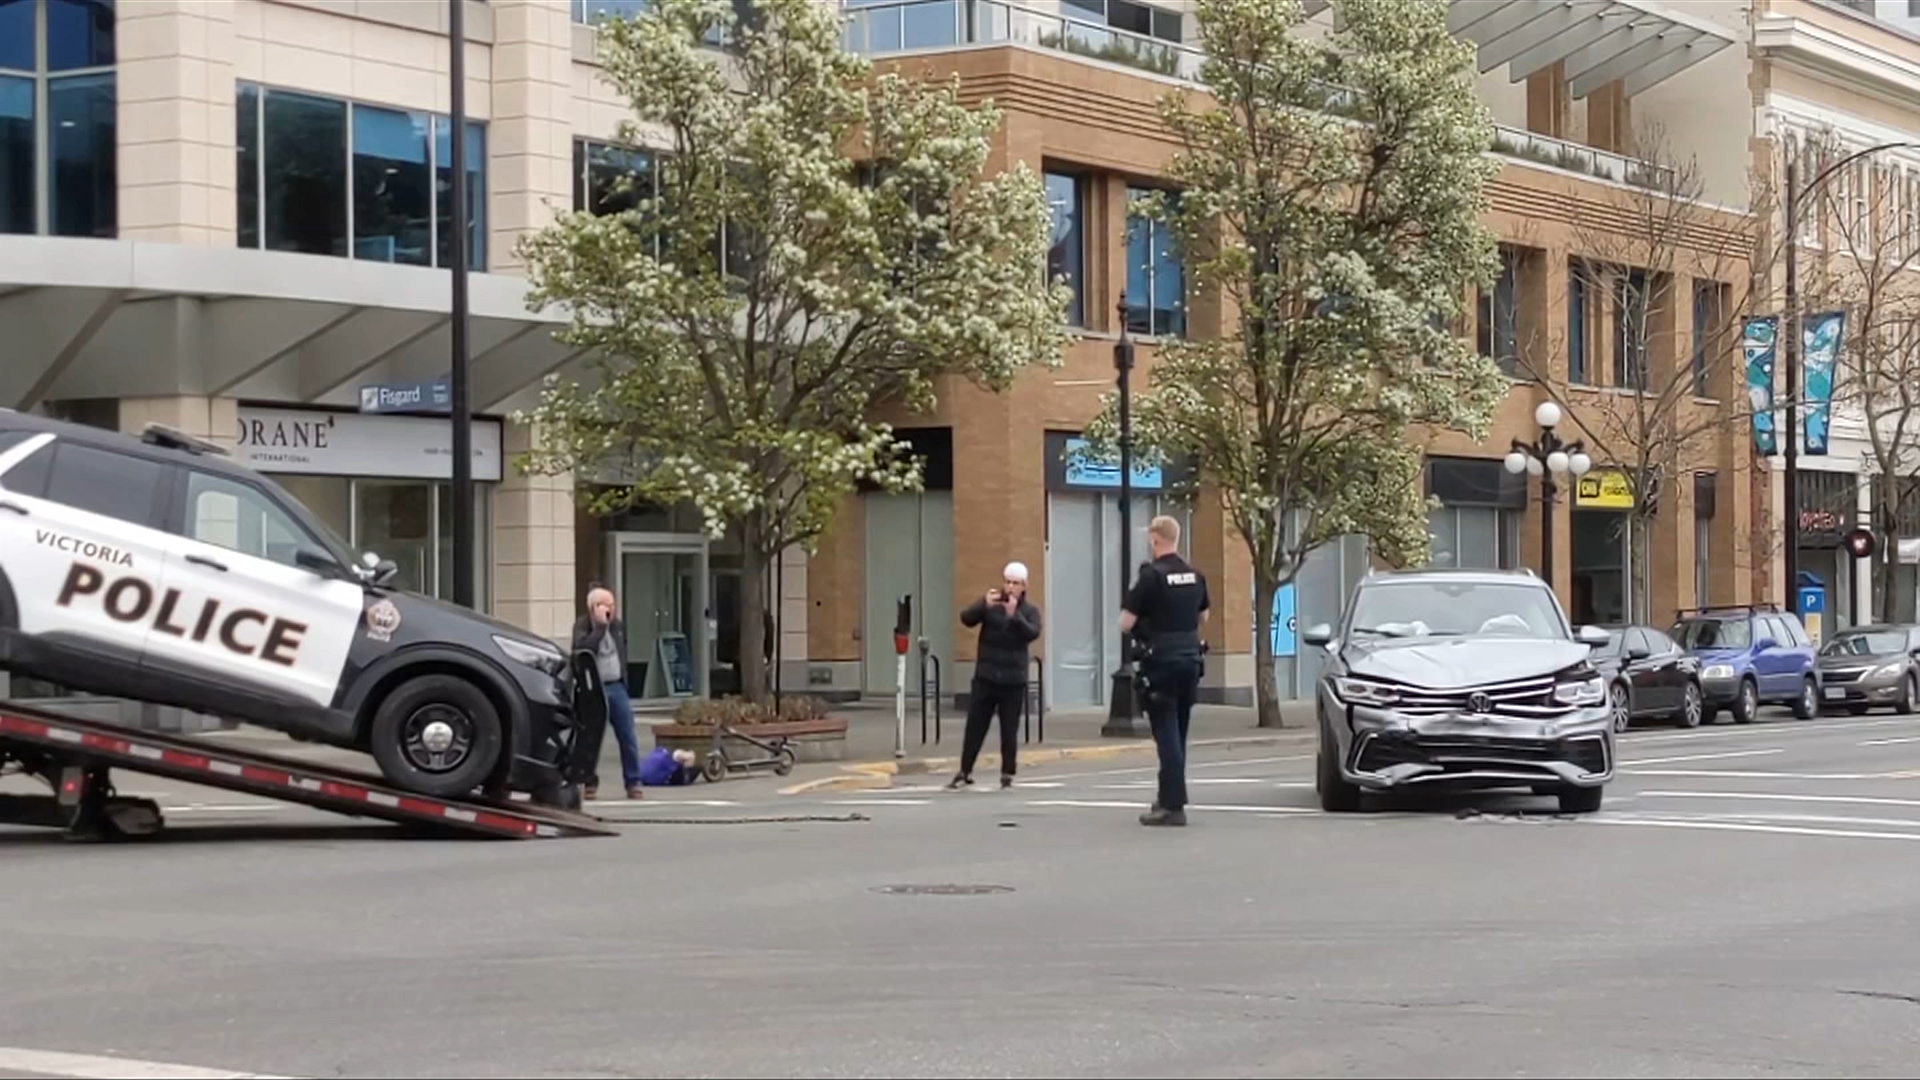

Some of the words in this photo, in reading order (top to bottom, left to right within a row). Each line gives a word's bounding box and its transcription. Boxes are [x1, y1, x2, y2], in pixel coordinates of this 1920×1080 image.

[380, 385, 420, 406] Fisgard
[35, 529, 133, 568] VICTORIA
[55, 560, 308, 667] POLICE
[1806, 595, 1816, 607] P
